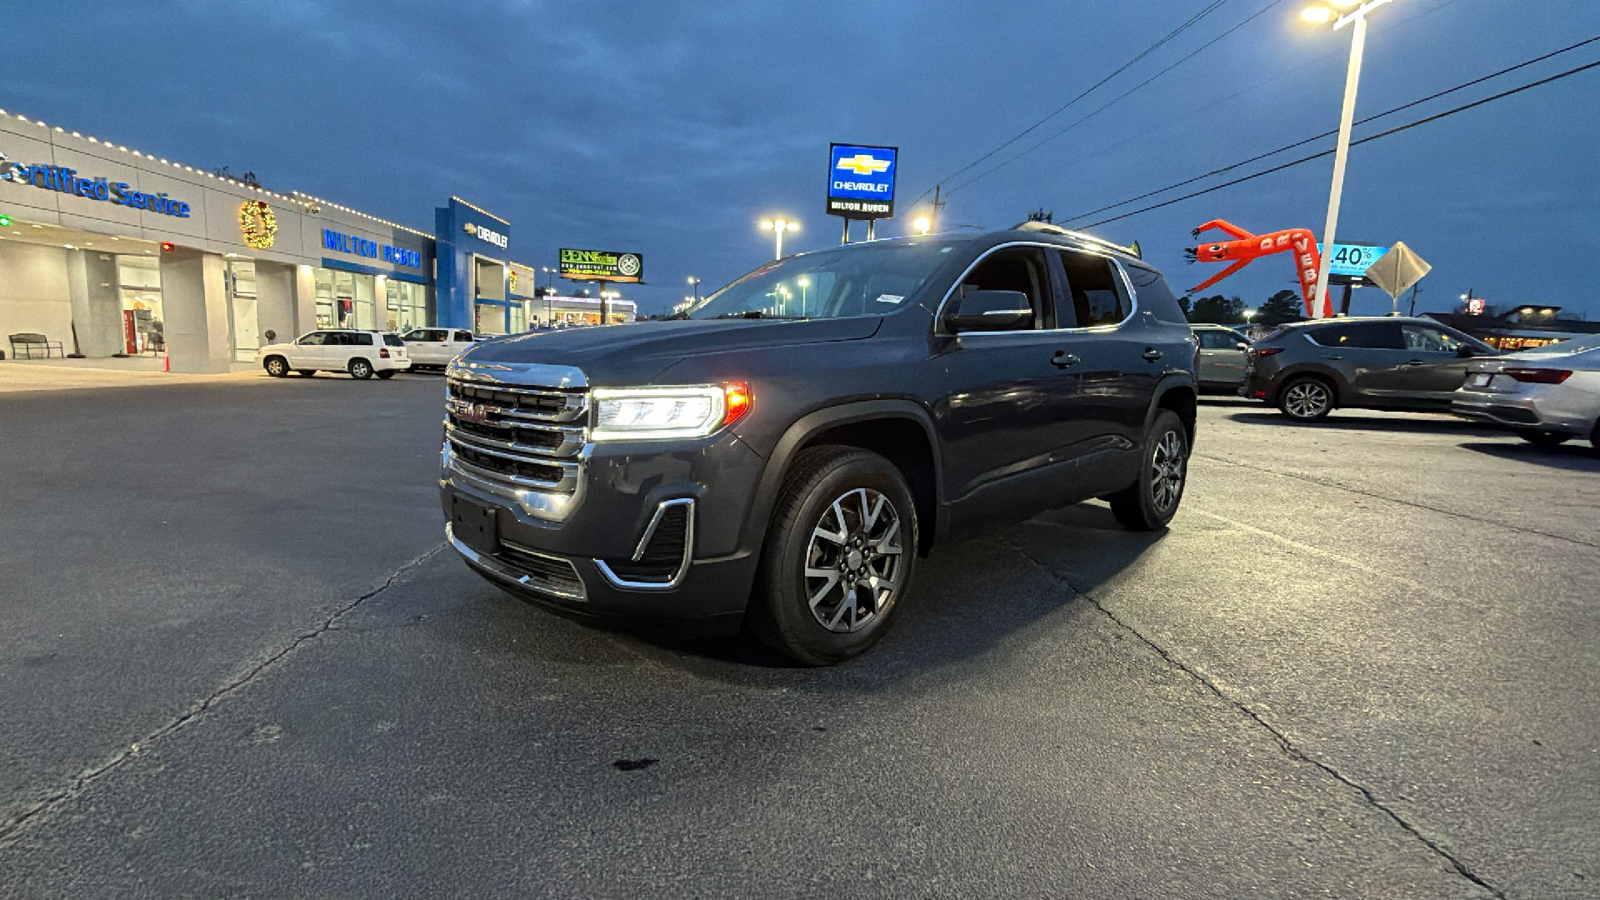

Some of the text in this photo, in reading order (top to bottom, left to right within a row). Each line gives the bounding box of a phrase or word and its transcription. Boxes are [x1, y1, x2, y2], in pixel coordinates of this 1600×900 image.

[833, 181, 889, 193] CHEVROLET
[115, 181, 191, 219] Service
[831, 201, 889, 213] MILTON RUBEN
[323, 227, 421, 269] MILTON RUBEN
[477, 225, 508, 249] CHEVROLET
[561, 249, 598, 263] PENN
[454, 400, 501, 427] GMC
